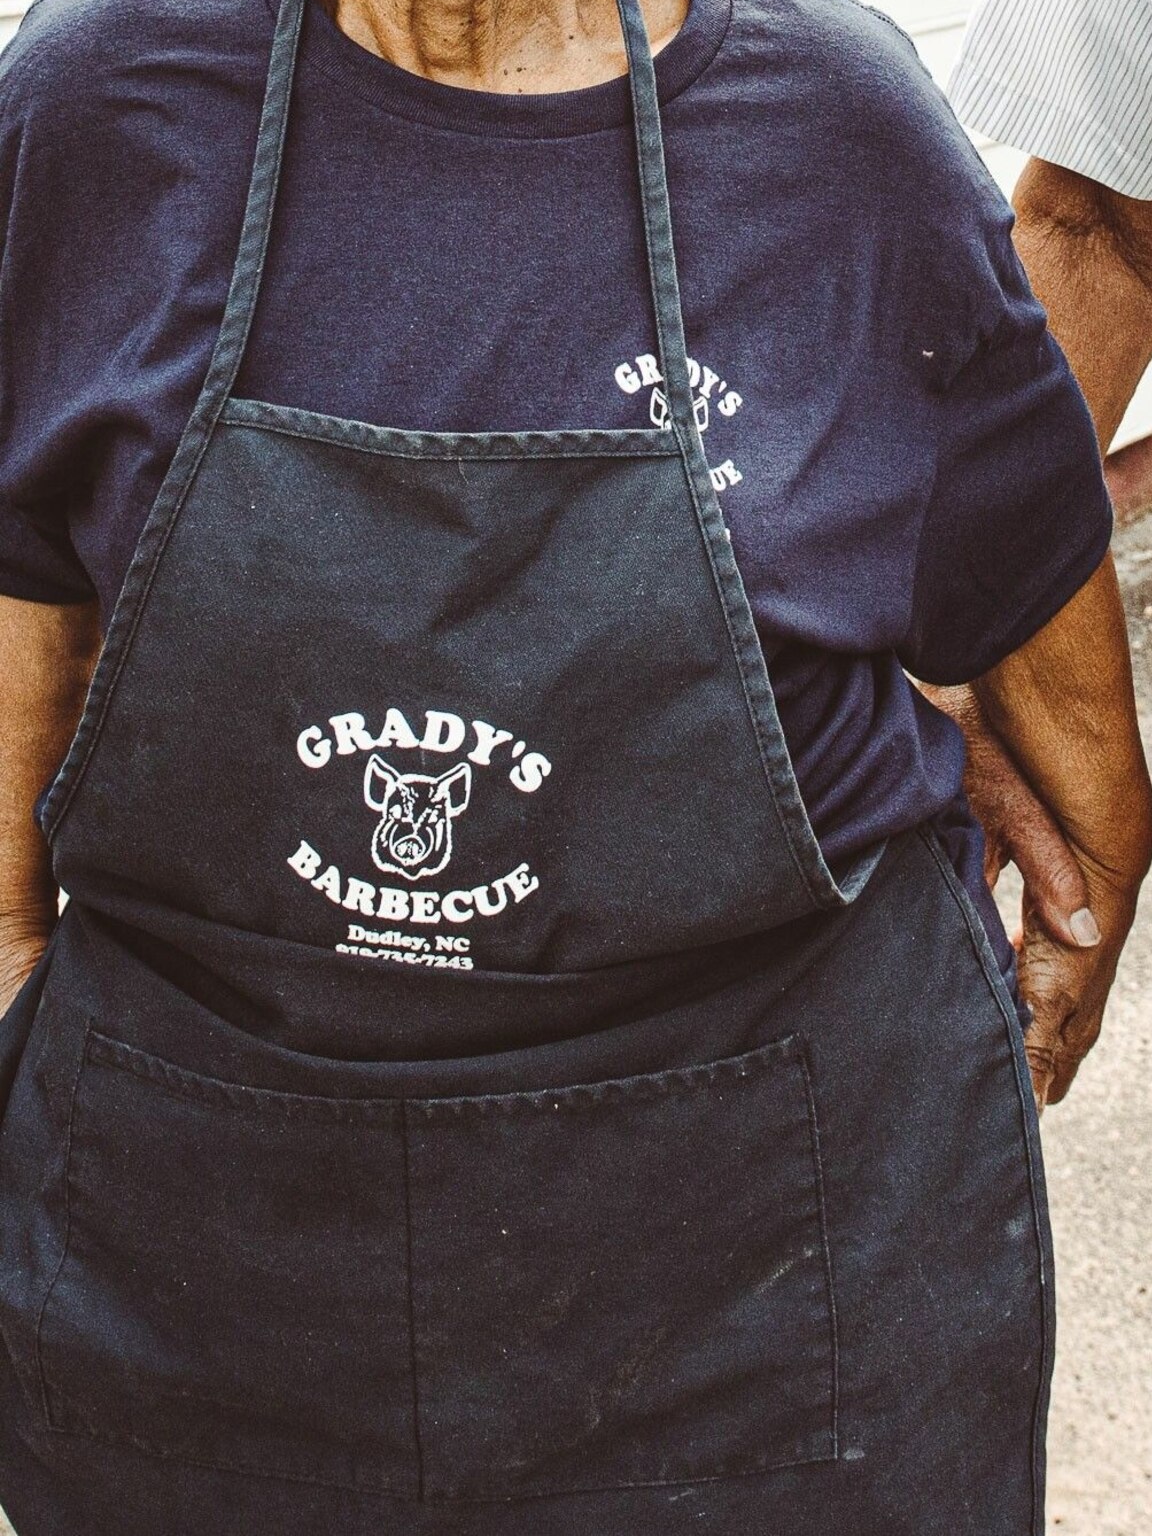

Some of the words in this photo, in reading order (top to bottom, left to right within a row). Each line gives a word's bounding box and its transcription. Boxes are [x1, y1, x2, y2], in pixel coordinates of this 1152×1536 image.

[614, 353, 744, 417] GRDY'S
[296, 707, 552, 793] GRADY'S
[286, 839, 540, 924] BARBECUE
[346, 924, 431, 952] Dudley,
[434, 935, 471, 953] NC
